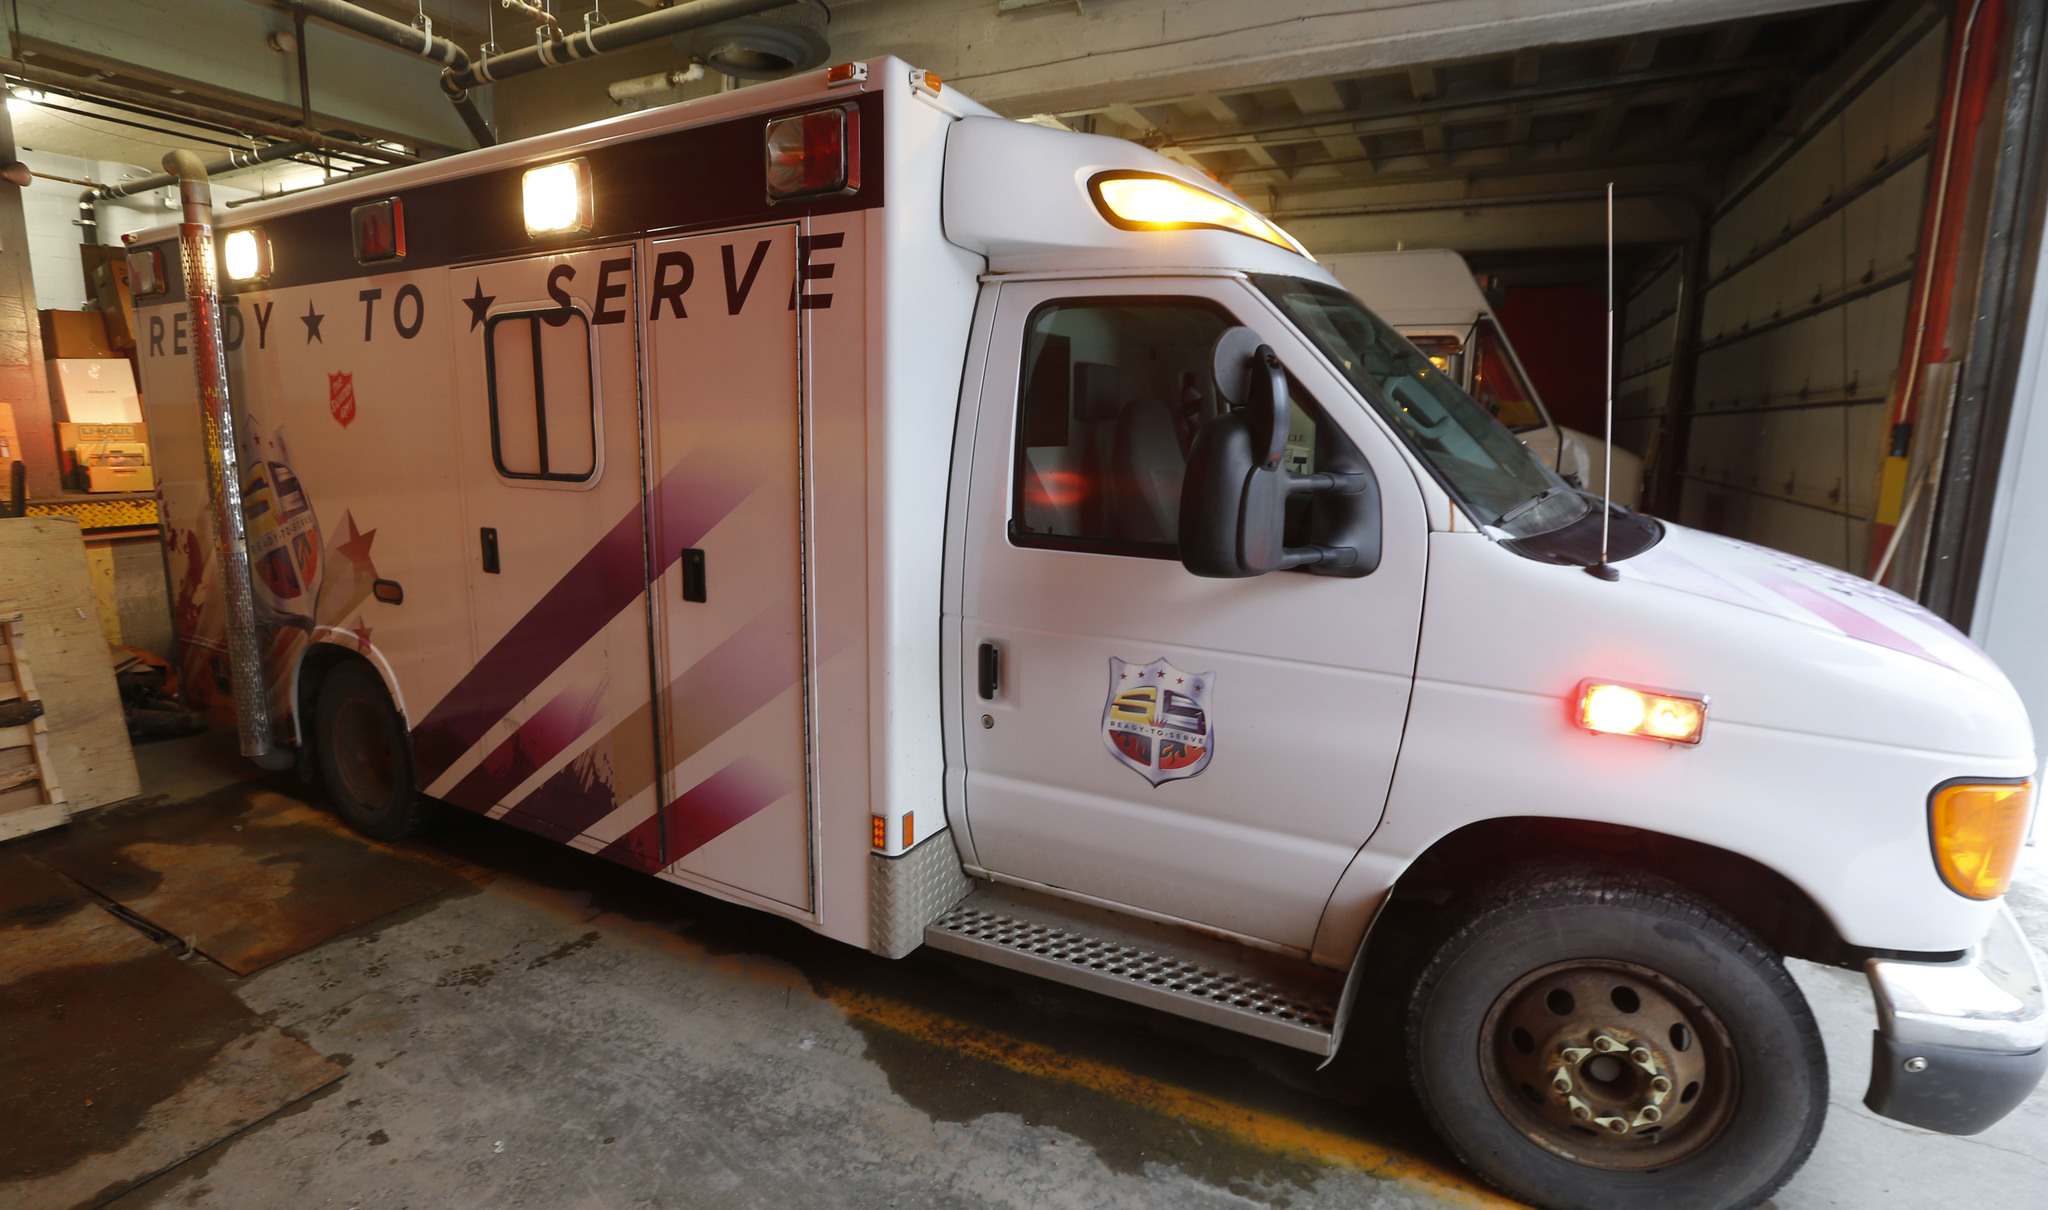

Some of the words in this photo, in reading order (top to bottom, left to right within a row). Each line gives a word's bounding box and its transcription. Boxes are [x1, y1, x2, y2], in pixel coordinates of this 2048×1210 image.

[150, 302, 273, 356] REDY
[359, 283, 424, 341] TO
[547, 232, 845, 327] SERVE
